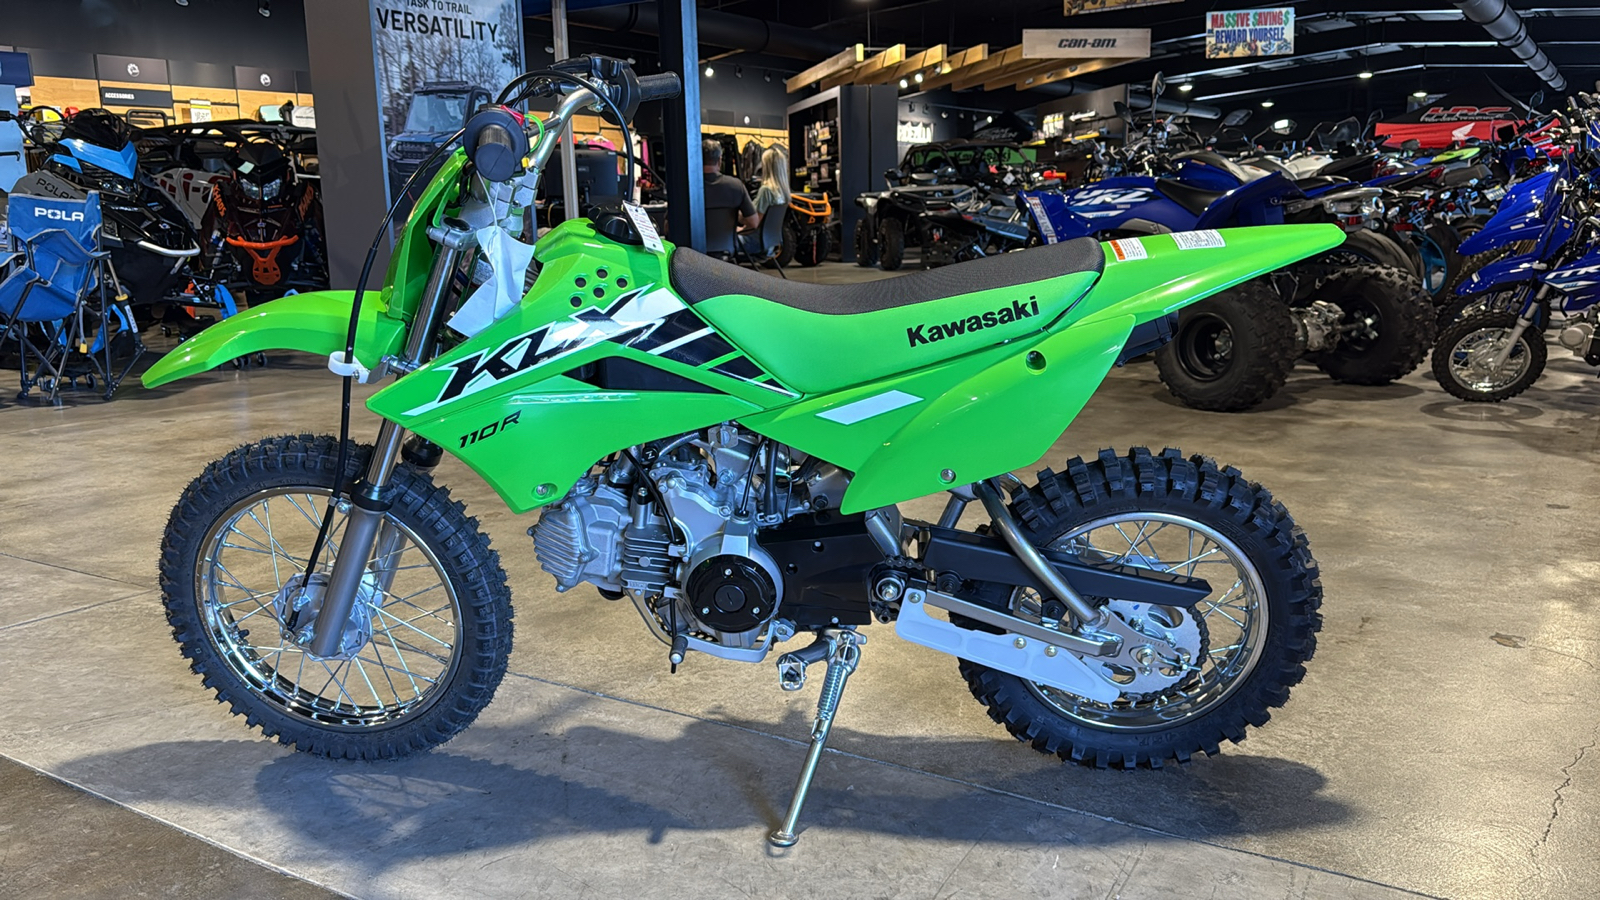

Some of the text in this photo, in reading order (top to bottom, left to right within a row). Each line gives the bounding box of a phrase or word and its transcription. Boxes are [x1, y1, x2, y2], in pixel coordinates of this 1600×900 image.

[431, 0, 444, 11] TO
[445, 2, 472, 15] TRAIL
[376, 7, 498, 42] VERSATILITY
[1058, 38, 1117, 48] can-am
[1215, 29, 1247, 44] REWARD
[1249, 27, 1285, 42] YOURSELF
[105, 92, 135, 100] ACCESSORIES
[34, 207, 84, 222] POLA
[906, 295, 1040, 348] Kawasaki
[435, 286, 656, 404] KLX
[459, 409, 522, 449] 110R
